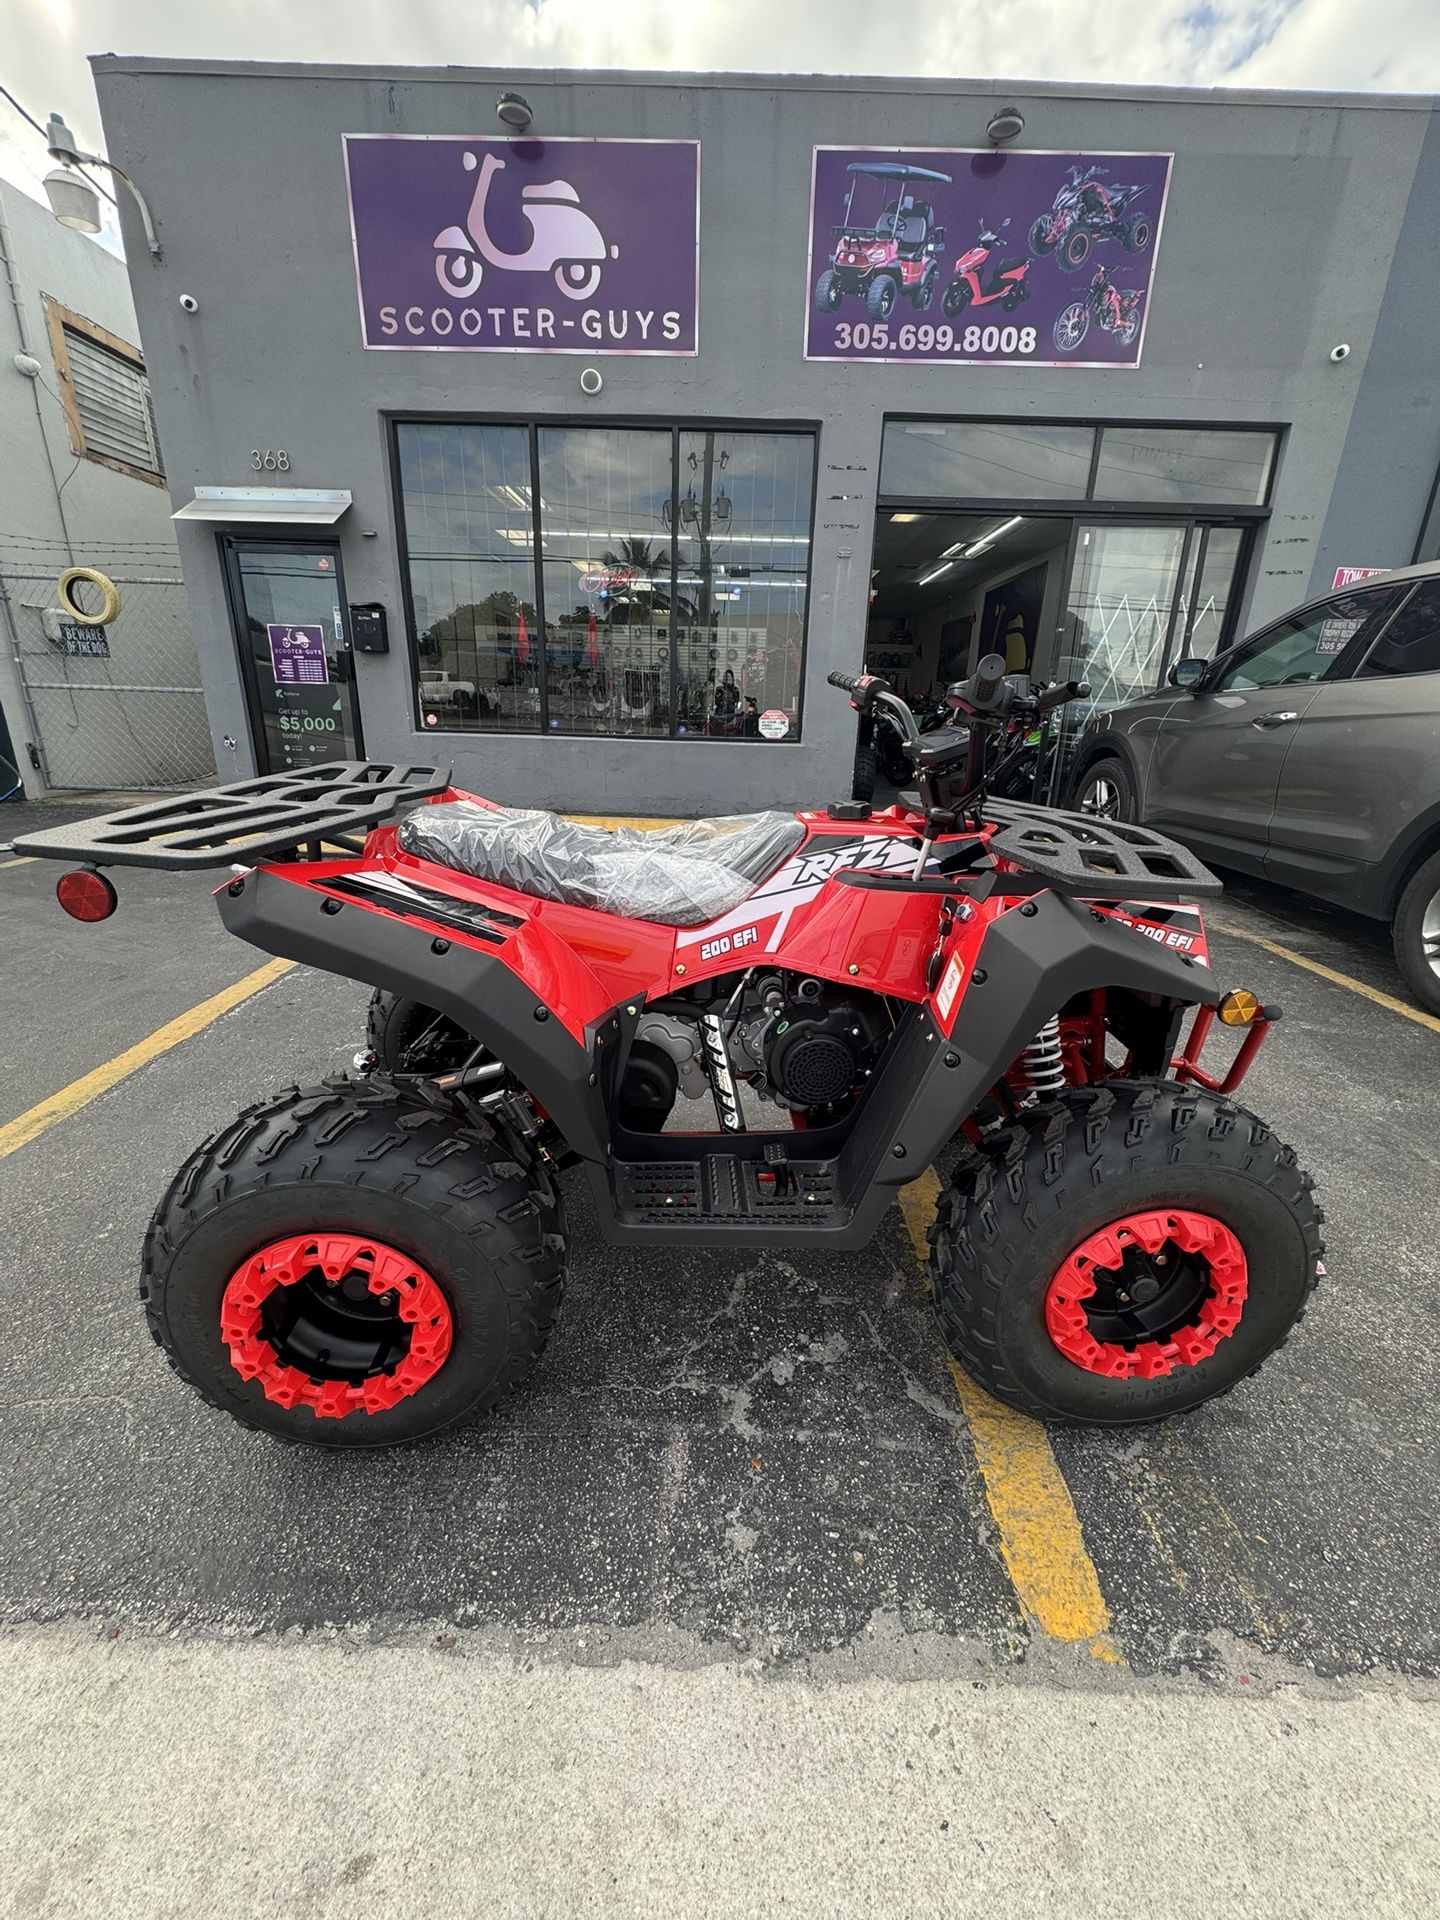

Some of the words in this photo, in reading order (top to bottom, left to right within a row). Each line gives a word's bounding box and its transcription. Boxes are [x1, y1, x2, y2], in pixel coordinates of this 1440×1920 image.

[380, 306, 681, 340] SCOOTER-GUYS
[834, 322, 1037, 354] 305.699.8008
[251, 449, 290, 471] 368
[64, 626, 105, 641] BEWARE
[78, 641, 91, 653] THE
[91, 641, 107, 654] DOG
[1320, 642, 1335, 650] 305
[278, 707, 291, 715] Get
[279, 714, 336, 733] $5,000
[700, 935, 732, 961] 200
[732, 925, 759, 950] EFI
[1165, 930, 1195, 951] EFI
